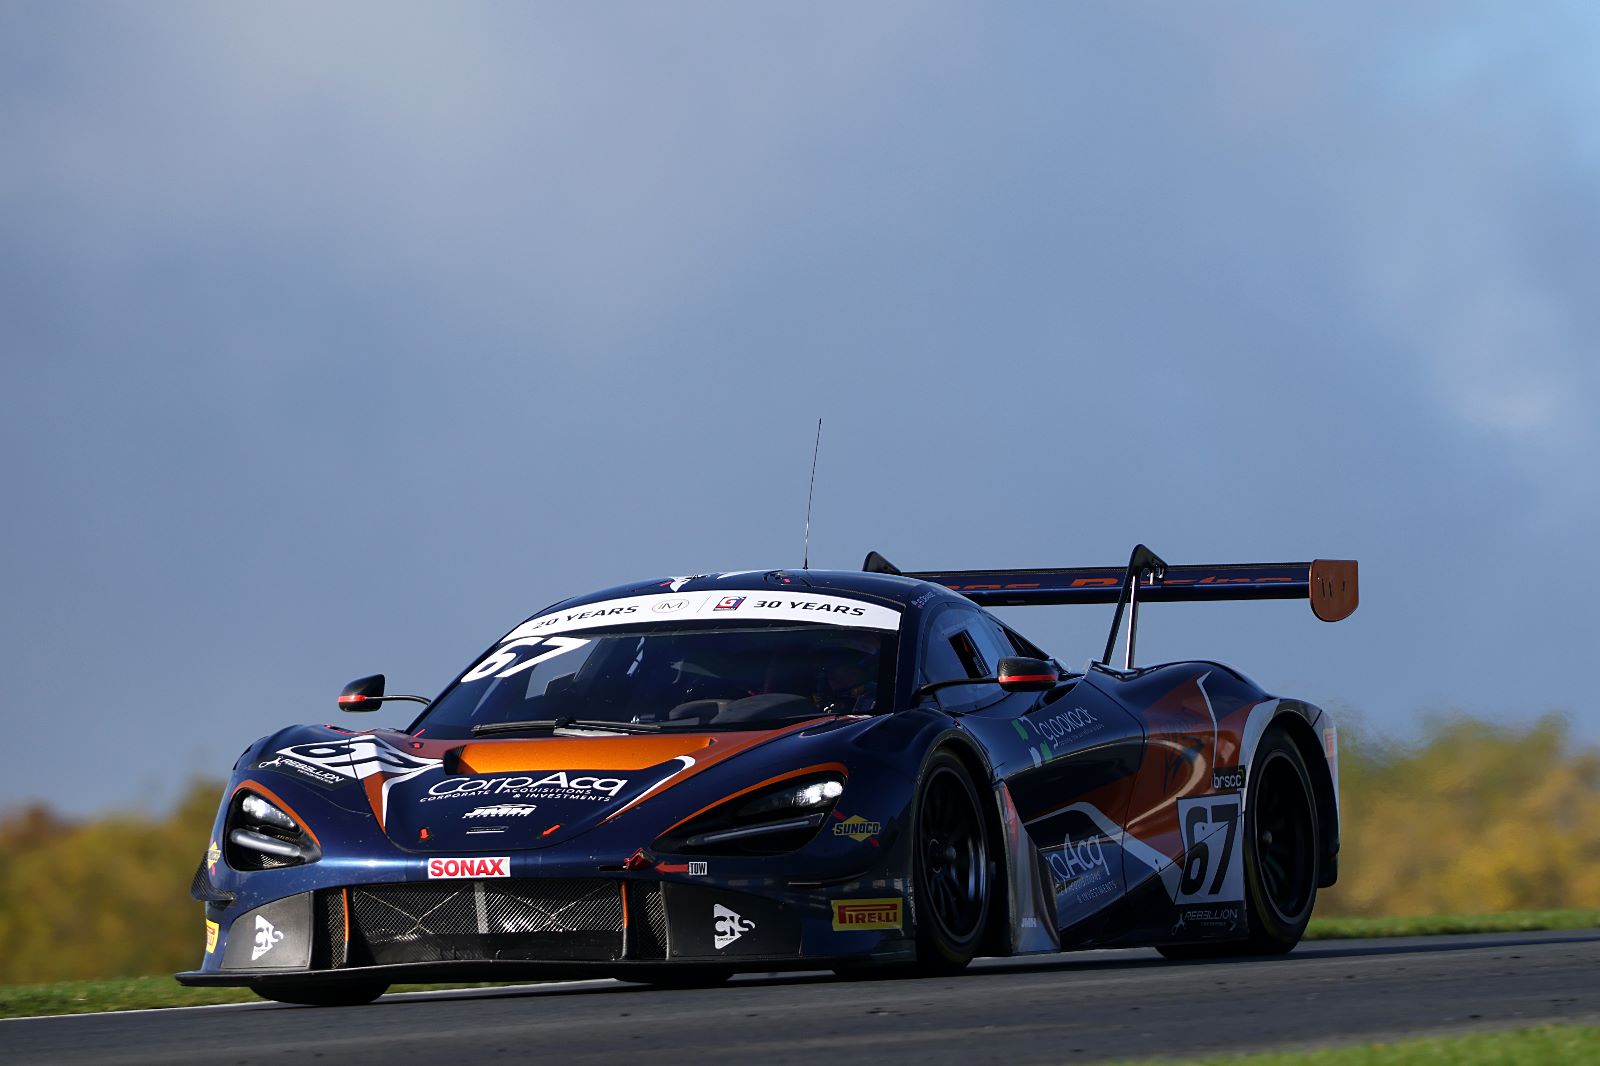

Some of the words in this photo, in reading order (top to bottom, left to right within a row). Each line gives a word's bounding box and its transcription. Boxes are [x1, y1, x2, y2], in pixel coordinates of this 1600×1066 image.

[754, 600, 782, 609] 30
[790, 601, 866, 616] YEARS
[532, 618, 560, 630] 20
[566, 606, 640, 622] YEARS
[460, 636, 592, 683] 67
[283, 759, 345, 783] REBELLION
[428, 772, 628, 796] CorpAcq
[1213, 773, 1242, 789] brscc
[419, 789, 491, 803] CORPORATE
[503, 787, 592, 795] ACQUISITIONS
[525, 792, 612, 803] INVESTMENTS
[835, 823, 880, 835] SUNOCO
[1181, 804, 1239, 895] 67
[430, 859, 505, 877] SONAX
[690, 863, 706, 875] TOW
[838, 904, 898, 924] PIRELLI
[1183, 908, 1239, 921] REBELLION
